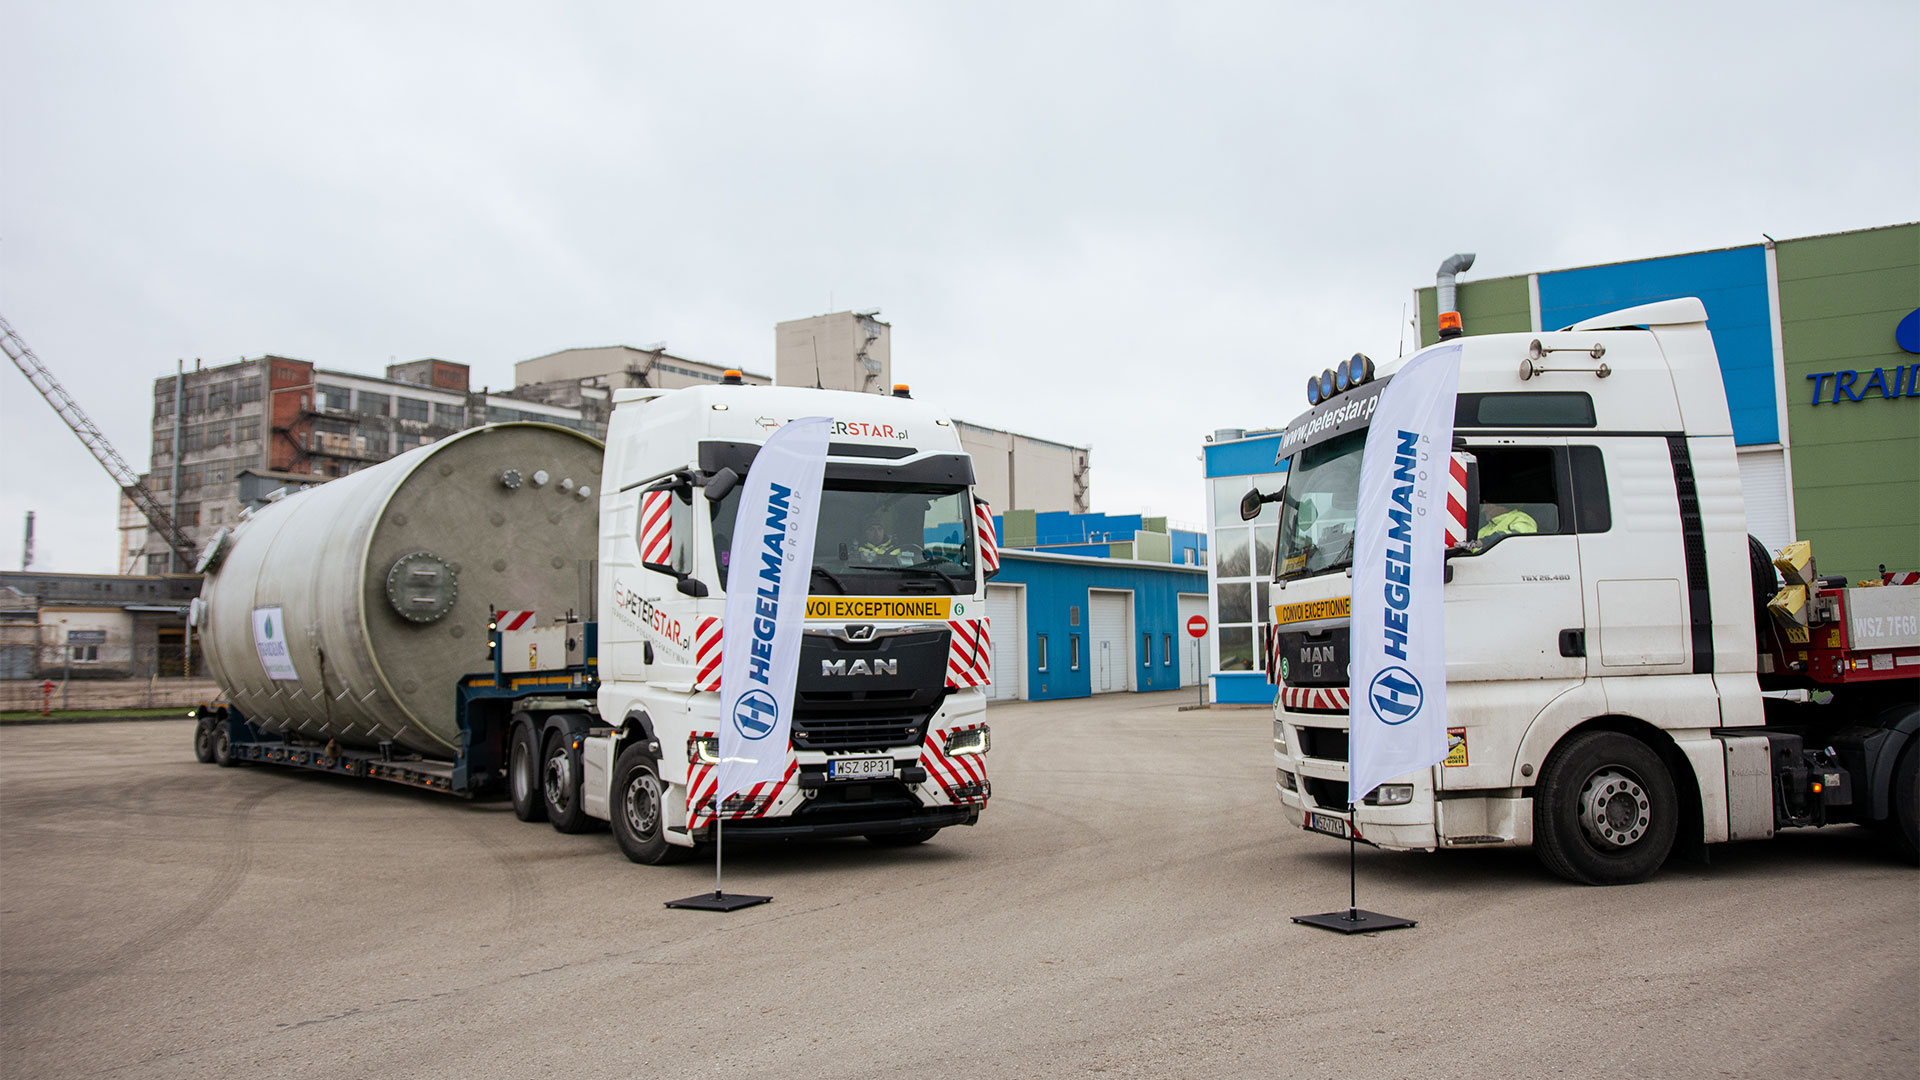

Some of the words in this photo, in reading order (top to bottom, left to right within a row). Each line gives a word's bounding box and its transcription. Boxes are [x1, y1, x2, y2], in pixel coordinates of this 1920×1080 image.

[1282, 386, 1386, 450] www.peterstar.pl
[1416, 434, 1431, 517] GROUP
[786, 490, 802, 562] GROUP
[1384, 429, 1420, 662] HEGELMANN
[748, 481, 792, 686] HEGELMANN
[625, 588, 691, 651] PETERSTAR.pl
[835, 601, 942, 617] EXCEPTIONNEL
[1282, 604, 1304, 622] CONVOI
[1305, 597, 1351, 619] EXCEPTIONNE
[1855, 616, 1885, 638] WSZ
[1886, 615, 1918, 637] 7F68
[821, 658, 898, 676] MAN
[1300, 645, 1335, 663] MAN
[837, 761, 859, 774] WSZ
[863, 760, 890, 773] 8P31
